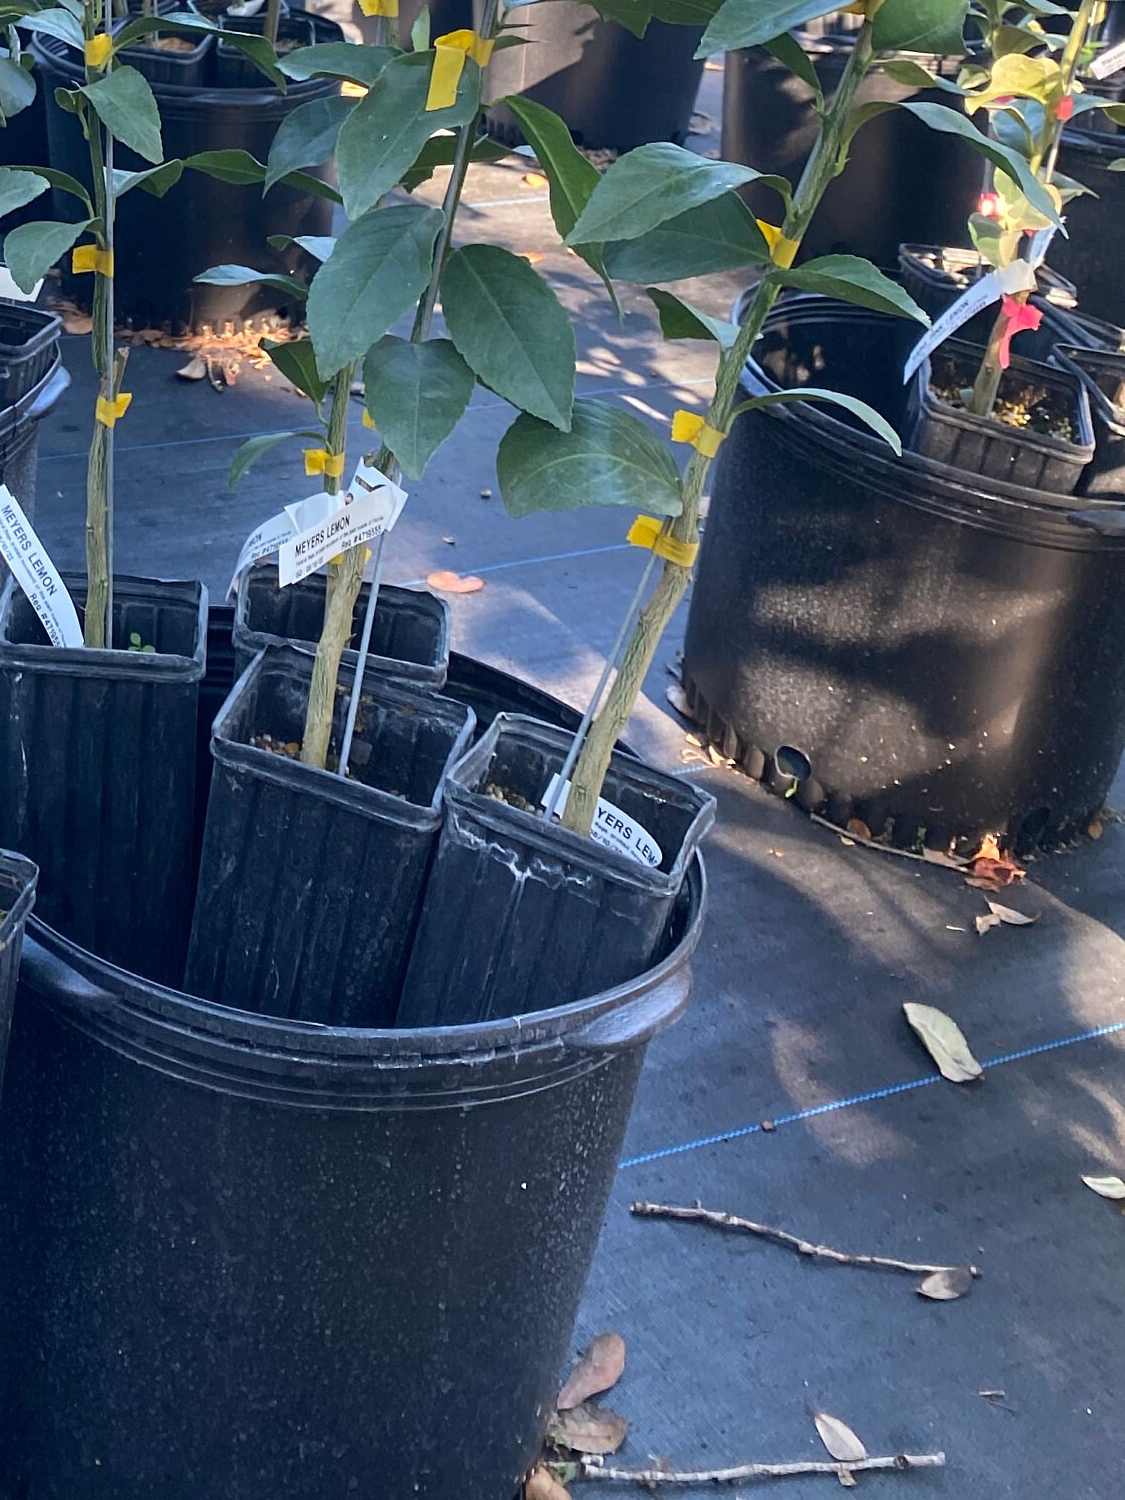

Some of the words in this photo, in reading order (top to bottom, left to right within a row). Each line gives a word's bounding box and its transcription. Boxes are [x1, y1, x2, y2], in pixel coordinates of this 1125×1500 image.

[0, 504, 32, 552] MEYERS
[28, 552, 58, 596] LEMON
[294, 530, 324, 557] MEYERS
[326, 515, 350, 539] LEMON
